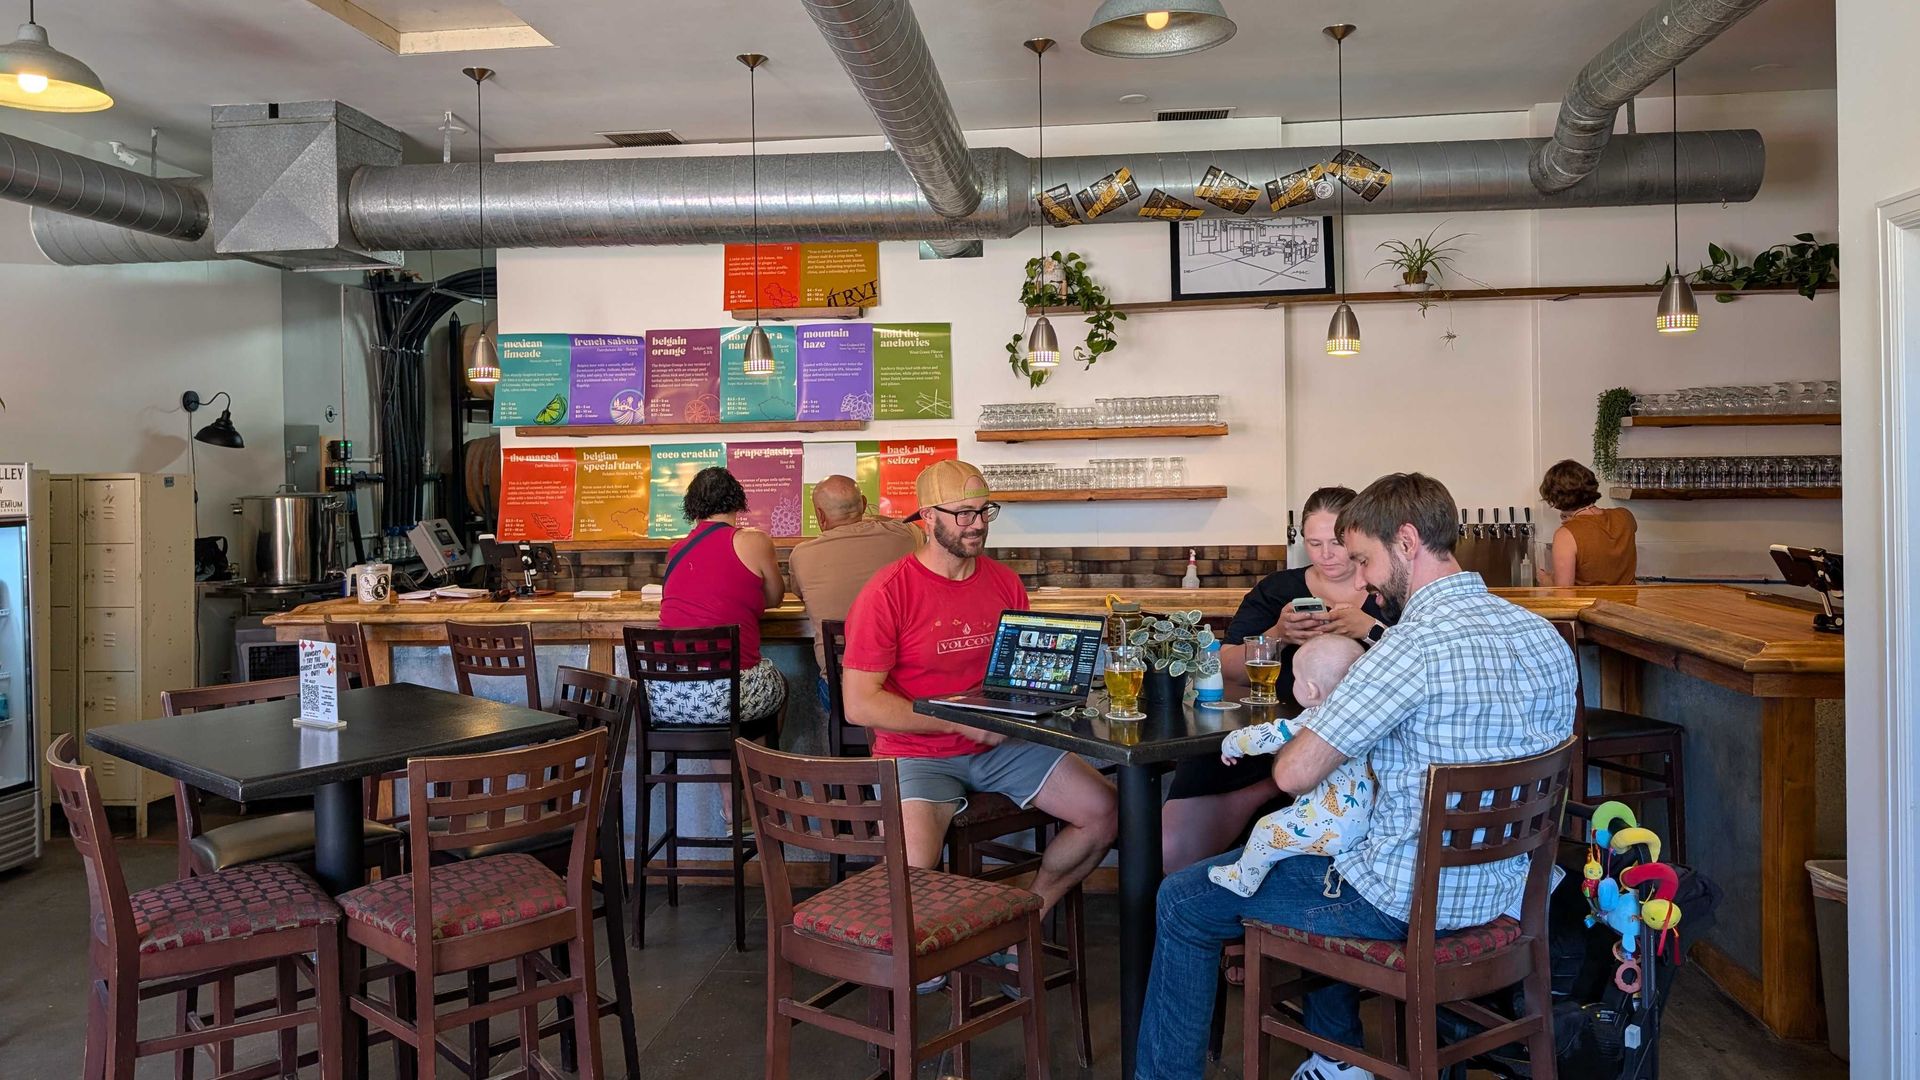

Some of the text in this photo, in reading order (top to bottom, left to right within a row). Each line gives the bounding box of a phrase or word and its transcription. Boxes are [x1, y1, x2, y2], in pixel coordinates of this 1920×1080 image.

[803, 328, 849, 338] mountain
[904, 330, 920, 338] the
[504, 339, 543, 348] mexican
[574, 337, 639, 347] french saison
[652, 336, 687, 347] belgain
[803, 340, 825, 348] haze
[880, 338, 930, 348] anchovies
[504, 349, 541, 359] limeade
[652, 347, 686, 356] orange
[681, 449, 721, 458] crackin'
[734, 448, 794, 459] grape gatsby
[887, 444, 936, 454] back alley
[510, 453, 524, 462] the
[583, 452, 618, 462] belgian
[887, 456, 920, 464] seltzer
[584, 461, 642, 472] special dark
[940, 635, 994, 650] VOLCOM
